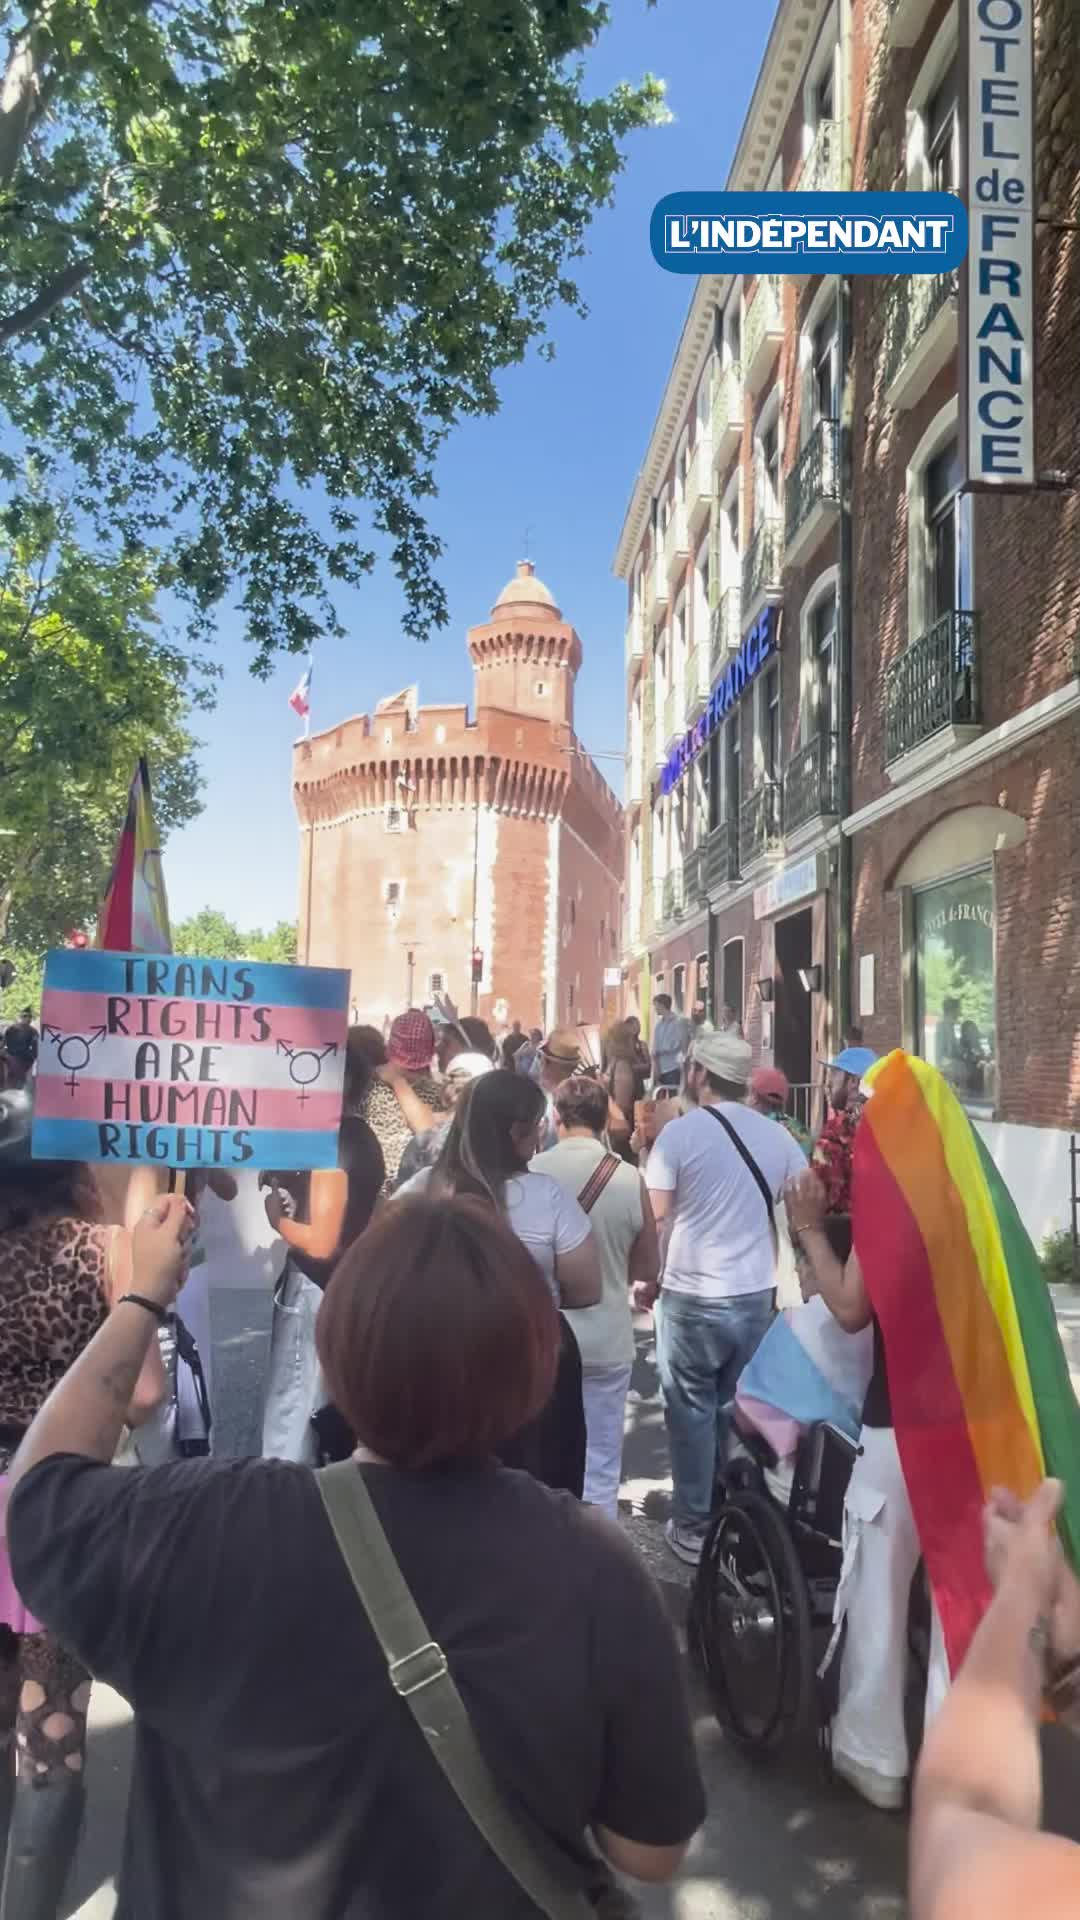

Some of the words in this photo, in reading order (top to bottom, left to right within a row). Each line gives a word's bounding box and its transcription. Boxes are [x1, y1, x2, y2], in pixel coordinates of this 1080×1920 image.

[975, 168, 1025, 205] de
[976, 213, 1025, 475] FRANCE
[705, 607, 770, 737] FRANCE
[121, 958, 256, 1001] TRANS
[106, 996, 272, 1042] RIGHTS
[135, 1041, 223, 1083] ARE
[103, 1082, 257, 1126] HUMAN
[97, 1123, 255, 1162] RIGHTS
